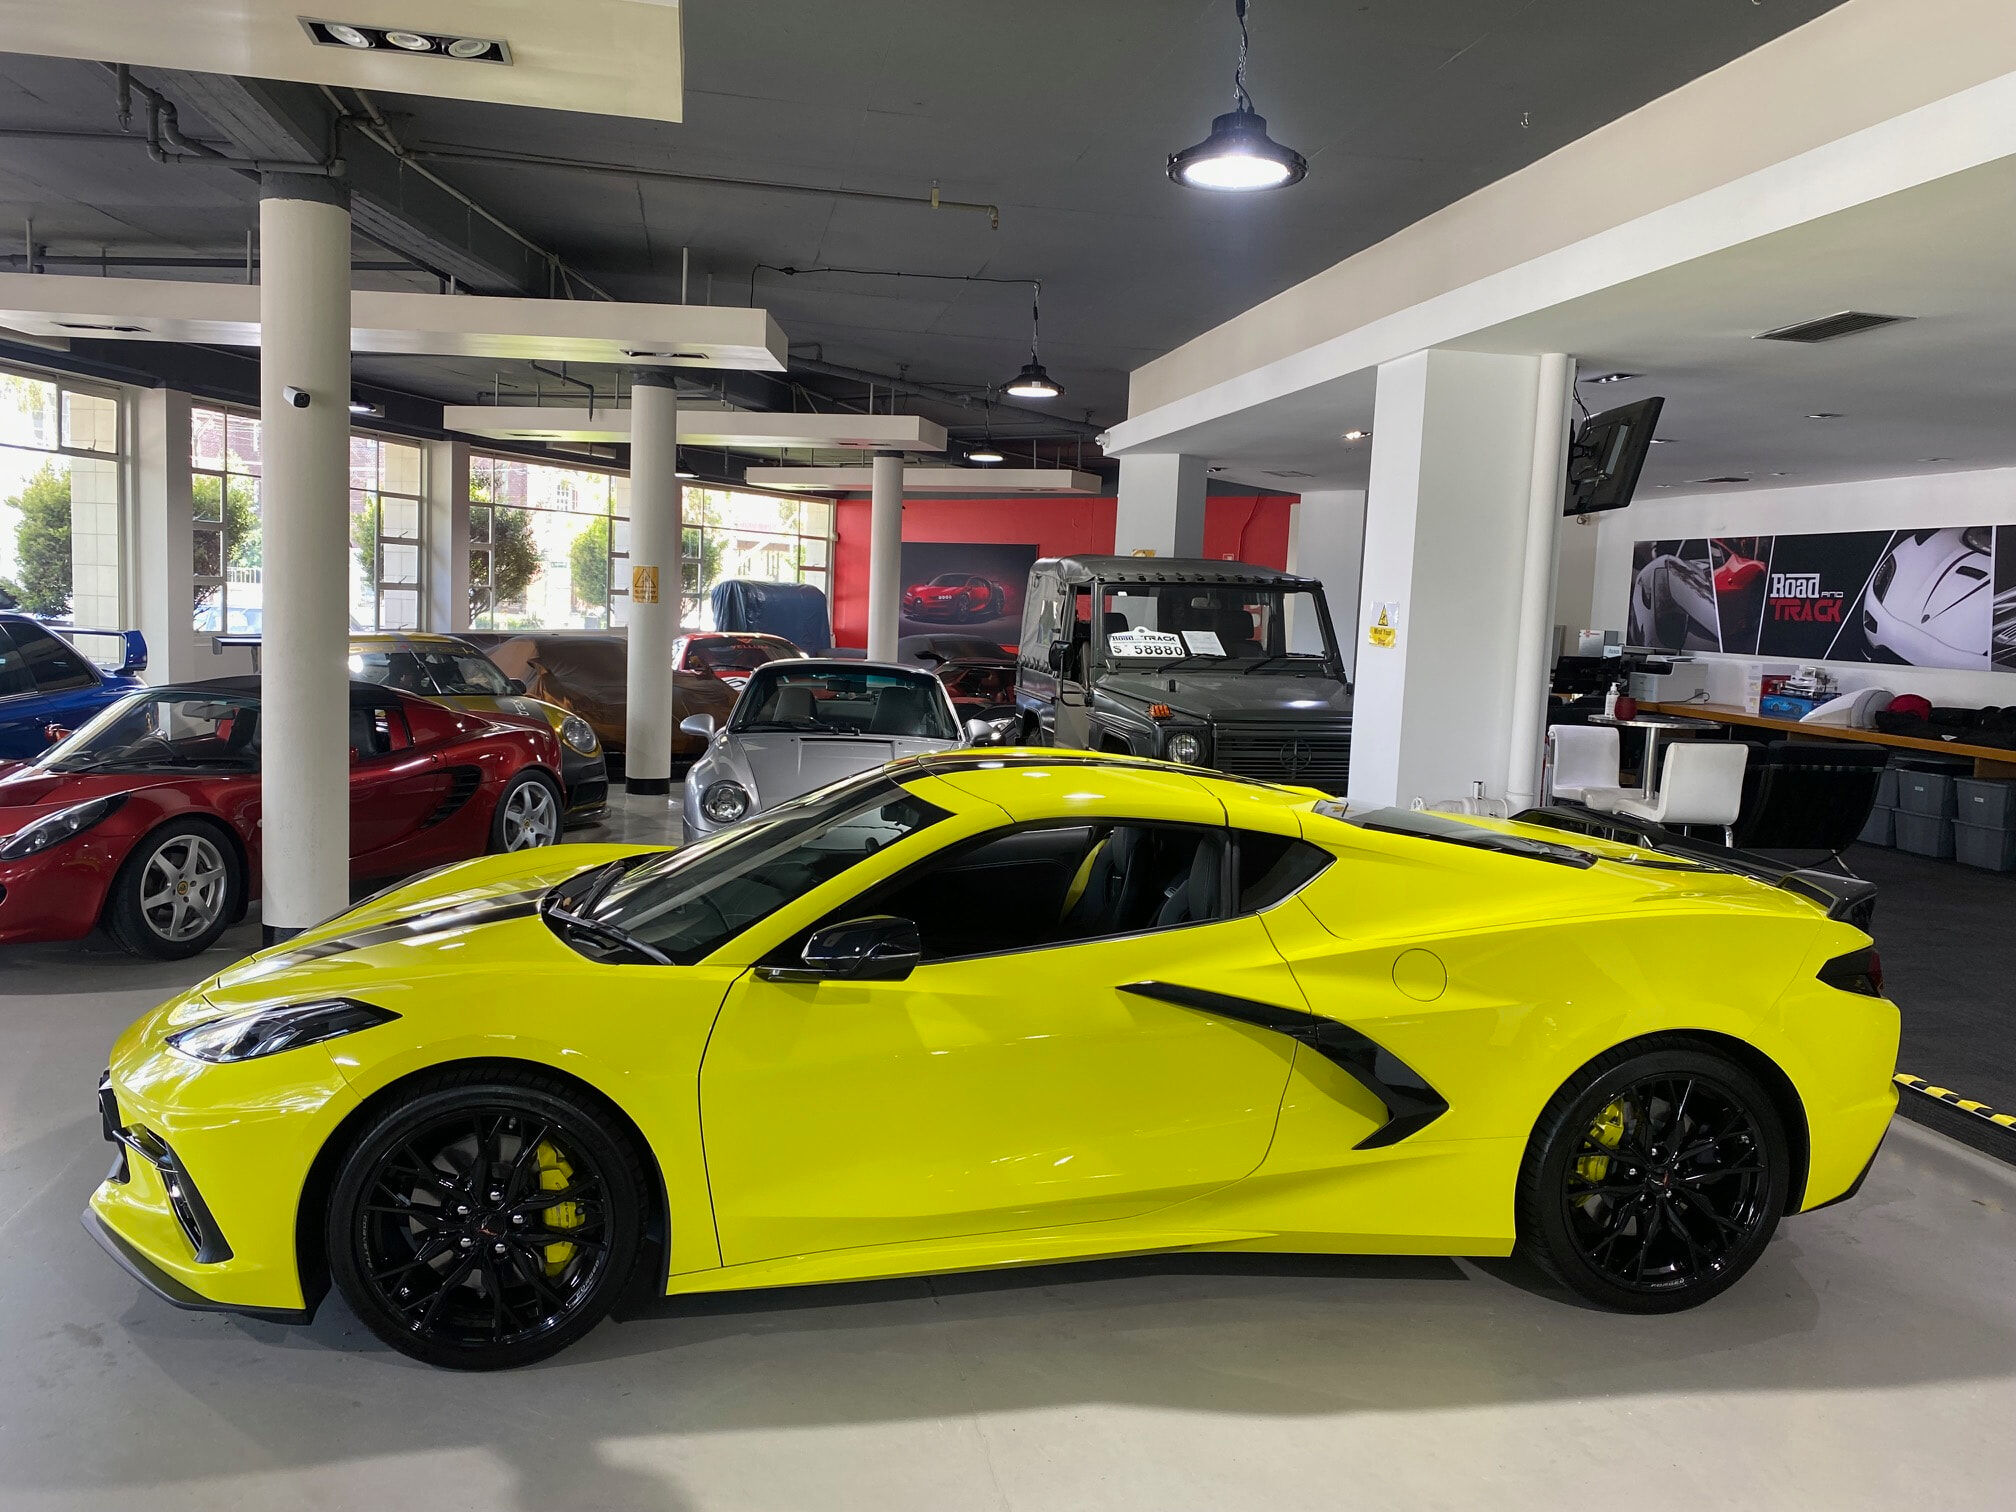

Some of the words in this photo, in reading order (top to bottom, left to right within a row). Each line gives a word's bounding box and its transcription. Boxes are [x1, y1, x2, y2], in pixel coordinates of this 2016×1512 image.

[1770, 573, 1820, 598] Road
[1769, 599, 1843, 622] TRACK
[1134, 645, 1183, 656] 58880
